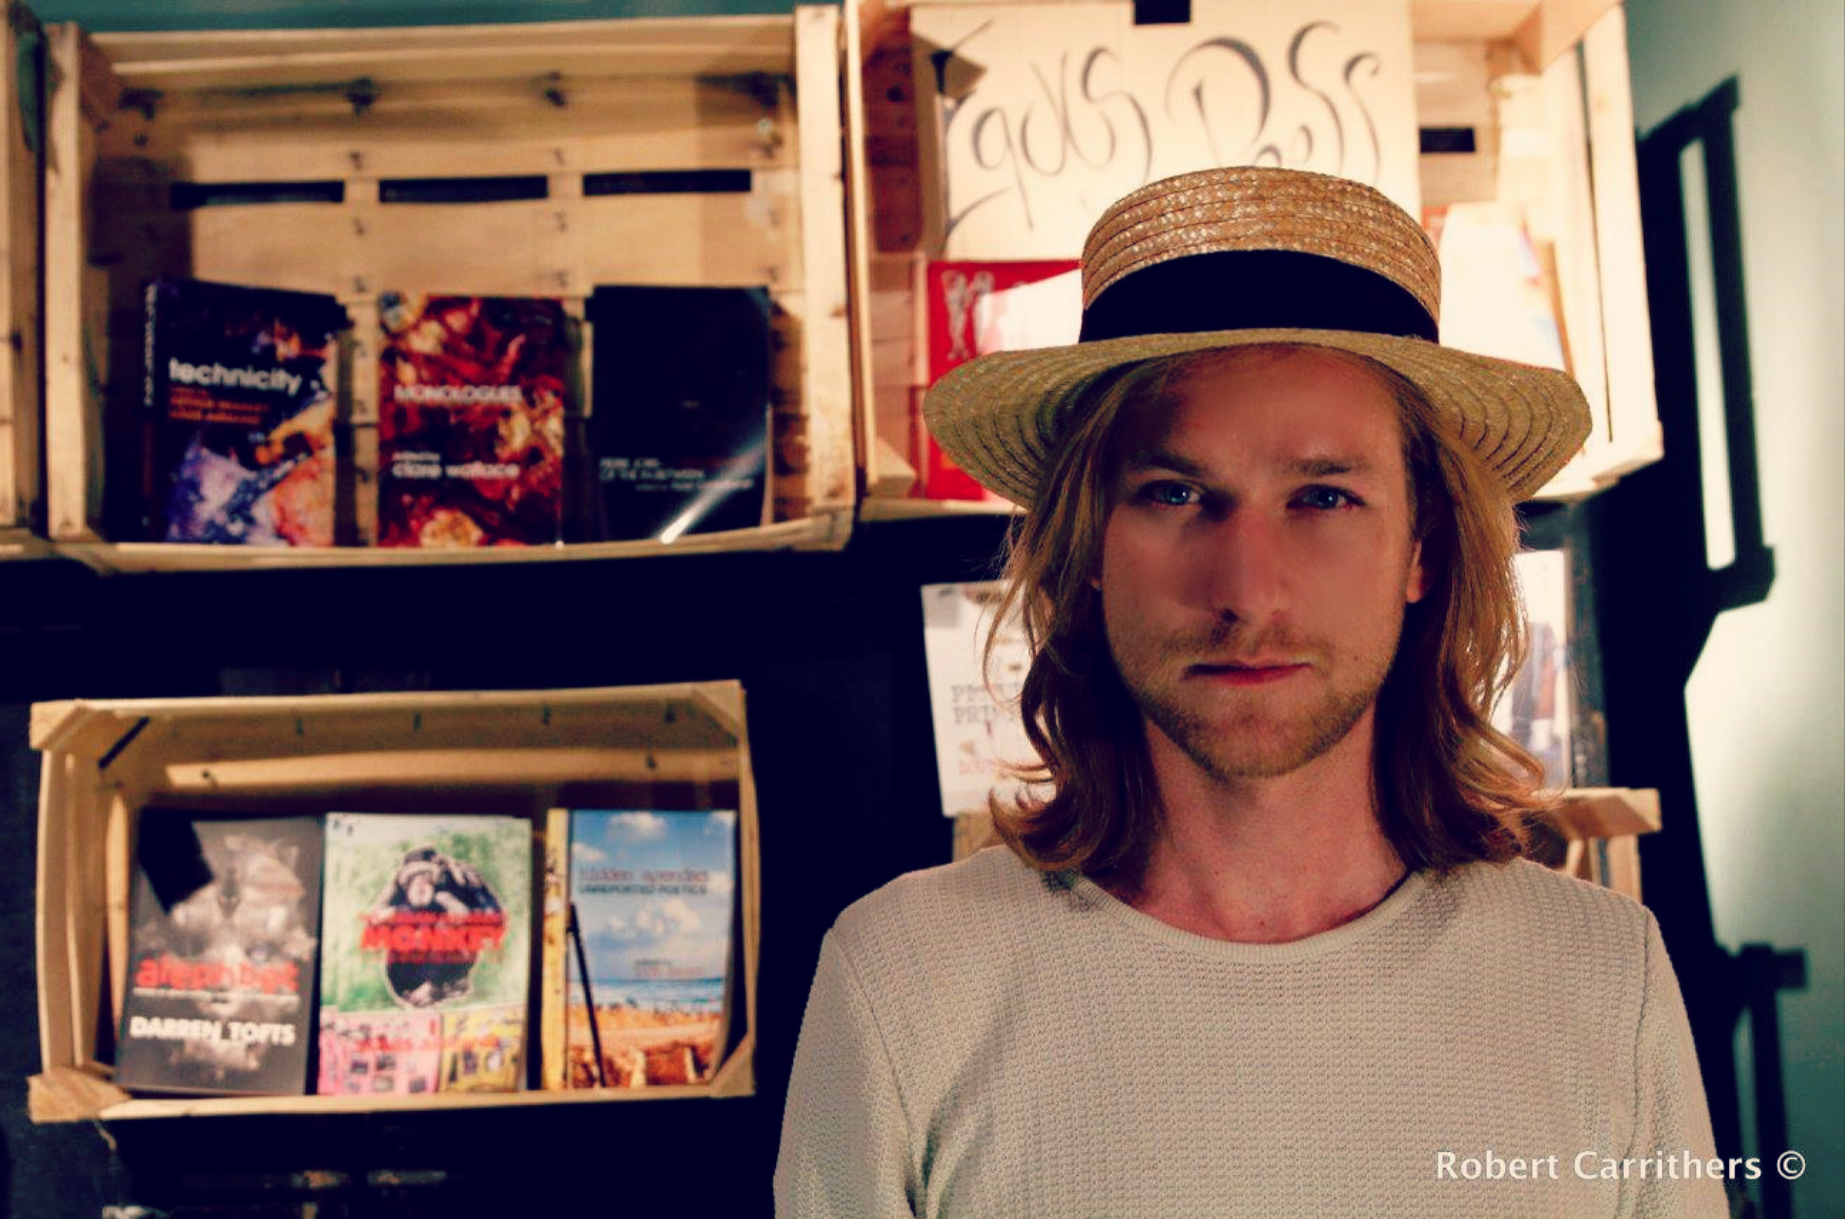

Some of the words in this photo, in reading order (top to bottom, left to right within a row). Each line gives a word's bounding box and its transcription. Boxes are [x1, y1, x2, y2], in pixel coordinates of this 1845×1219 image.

[169, 358, 302, 396] technicity
[393, 384, 521, 404] MONOLOGUES
[129, 1016, 222, 1042] DARREN
[227, 1021, 296, 1046] TOFTS
